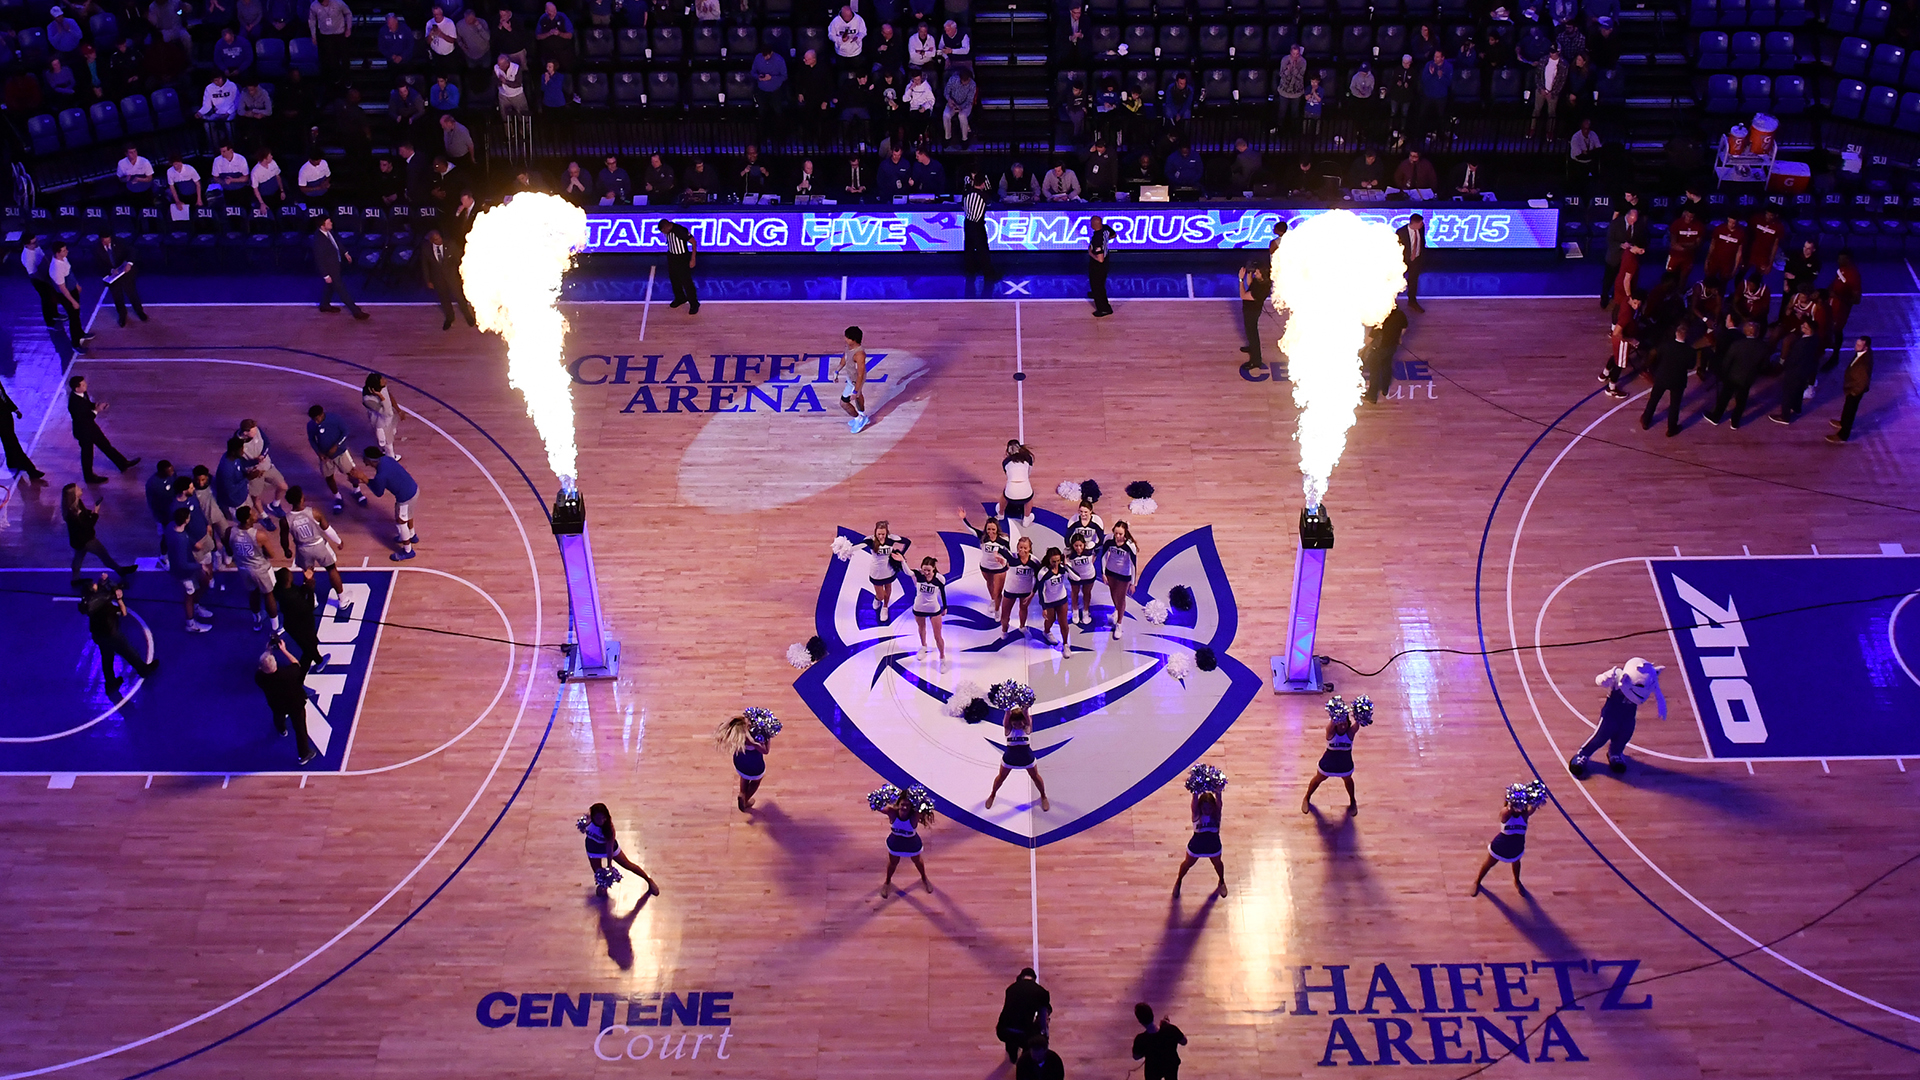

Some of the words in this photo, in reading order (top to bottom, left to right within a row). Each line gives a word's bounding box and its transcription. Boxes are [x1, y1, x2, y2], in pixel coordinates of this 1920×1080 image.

[1846, 144, 1862, 154] SLU
[1872, 156, 1888, 165] SLU
[1783, 177, 1795, 187] G
[1594, 197, 1609, 206] SLU
[1653, 198, 1668, 207] SLU
[1796, 195, 1811, 204] SLU
[1826, 195, 1841, 204] SLU
[1855, 196, 1871, 205] SLU
[1884, 196, 1899, 205] SLU
[5, 208, 20, 217] SLU
[31, 210, 46, 219] SLU
[60, 207, 75, 216] SLU
[87, 209, 102, 218] SLU
[116, 206, 131, 215] SLU
[142, 209, 157, 218] SLU
[198, 209, 213, 218] SLU
[226, 207, 241, 216] SLU
[281, 207, 296, 216] SLU
[338, 206, 353, 215] SLU
[365, 209, 380, 218] SLU
[394, 207, 409, 216] SLU
[420, 208, 435, 217] SLU
[585, 218, 789, 247] TARTING
[801, 218, 909, 246] FIVE
[1426, 214, 1511, 242] #15
[567, 353, 889, 386] CHAIFETZ
[619, 384, 827, 414] ARENA
[920, 584, 936, 594] SLU
[1243, 959, 1653, 1016] HAIFETZ
[475, 991, 734, 1036] CENTENE
[593, 1024, 734, 1061] Court
[1317, 1015, 1590, 1067] ARENA
